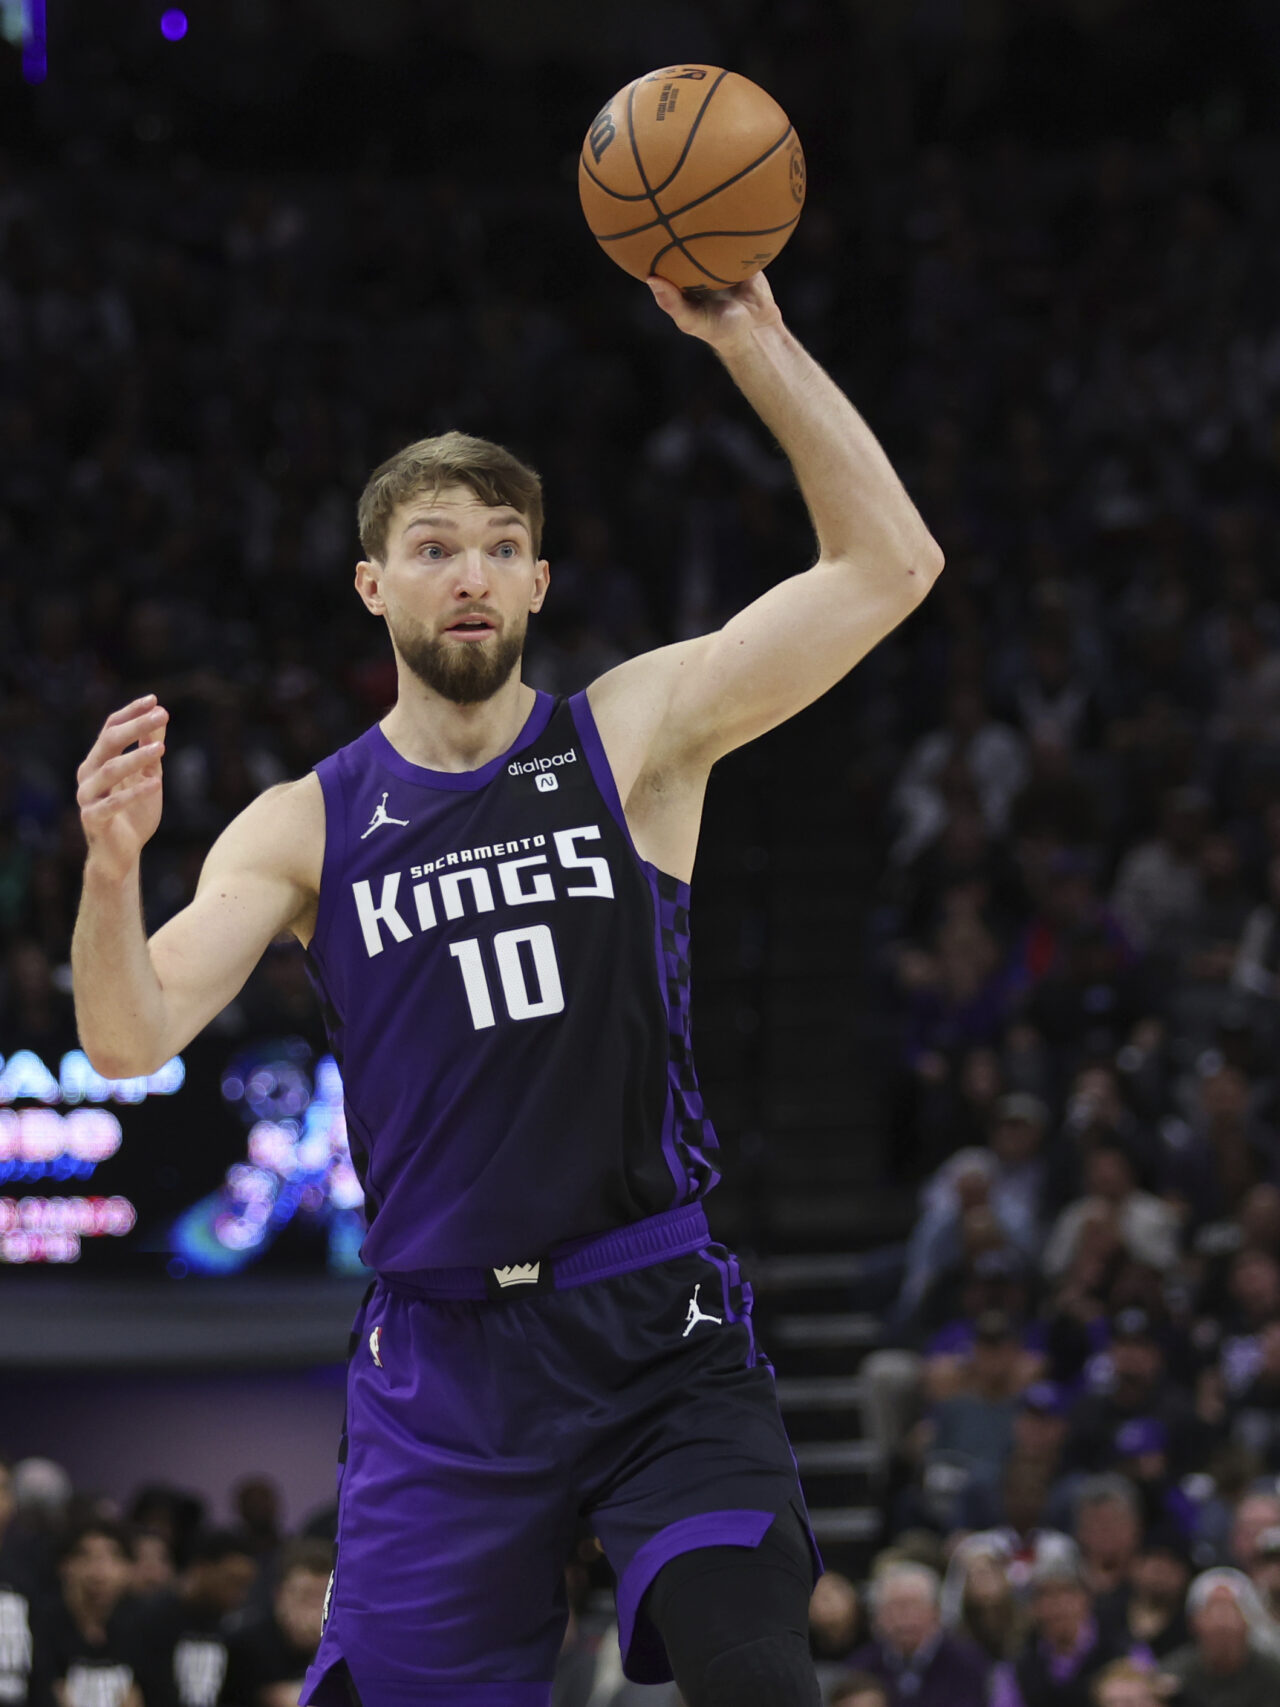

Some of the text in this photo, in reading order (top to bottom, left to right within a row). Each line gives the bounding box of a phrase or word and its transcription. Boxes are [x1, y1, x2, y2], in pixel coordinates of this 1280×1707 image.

[508, 748, 577, 776] dialpad
[410, 834, 546, 879] SACRAMENTO
[449, 924, 565, 1031] 10
